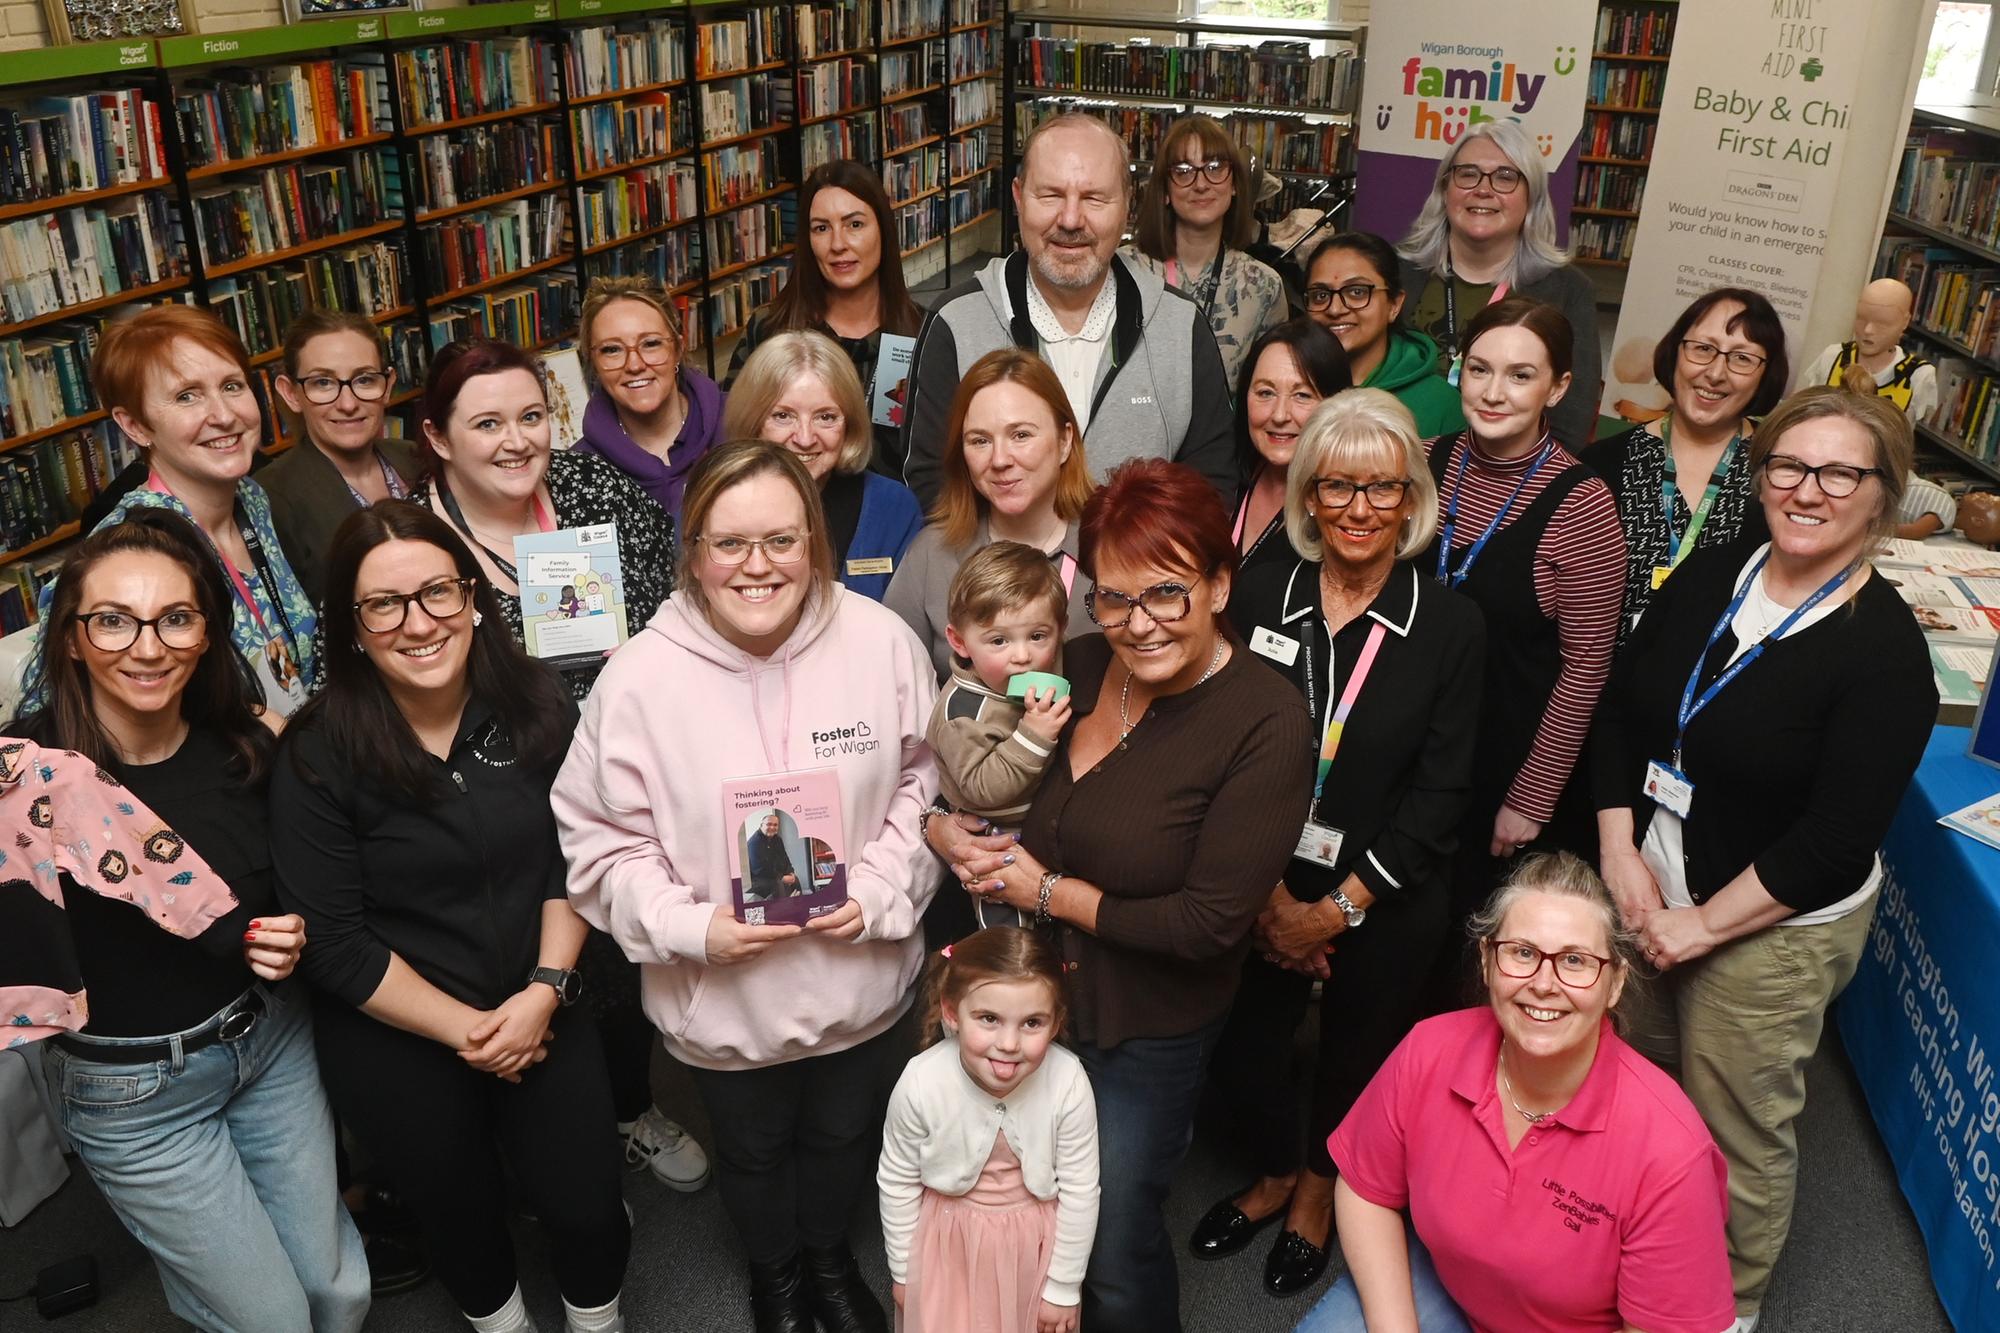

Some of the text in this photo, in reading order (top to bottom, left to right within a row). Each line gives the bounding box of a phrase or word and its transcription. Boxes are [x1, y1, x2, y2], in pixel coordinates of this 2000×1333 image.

[418, 17, 445, 28] Fiction
[203, 40, 239, 53] Fiction
[1778, 23, 1828, 53] FIRST
[120, 46, 145, 57] Wigan
[120, 55, 147, 65] Council
[1421, 42, 1503, 59] Wigan Borough
[1761, 53, 1795, 79] AID
[1402, 57, 1546, 113] family
[1694, 86, 1850, 130] Baby & Chi
[1717, 128, 1832, 166] First Aid
[1777, 192, 1798, 203] DEN
[1668, 201, 1707, 218] Would
[1708, 210, 1731, 222] you
[1734, 213, 1769, 228] know
[1771, 219, 1799, 234] how
[1802, 226, 1815, 237] to
[1668, 220, 1824, 256] your child in an emergenc
[1708, 255, 1785, 277] CLASSES COVER:
[1131, 396, 1151, 404] BOSS
[261, 566, 277, 599] PROGRESS
[1305, 646, 1313, 680] PROGRESS
[812, 727, 855, 744] Foster
[814, 740, 880, 760] For Wigan
[734, 785, 801, 800] Thinking about
[735, 798, 780, 809] fostering?
[1880, 850, 2000, 1143] rightington, Wig
[1897, 961, 1965, 1128] Teaching
[1909, 1062, 1994, 1270] NHS Foundation
[1542, 1178, 1566, 1196] Little
